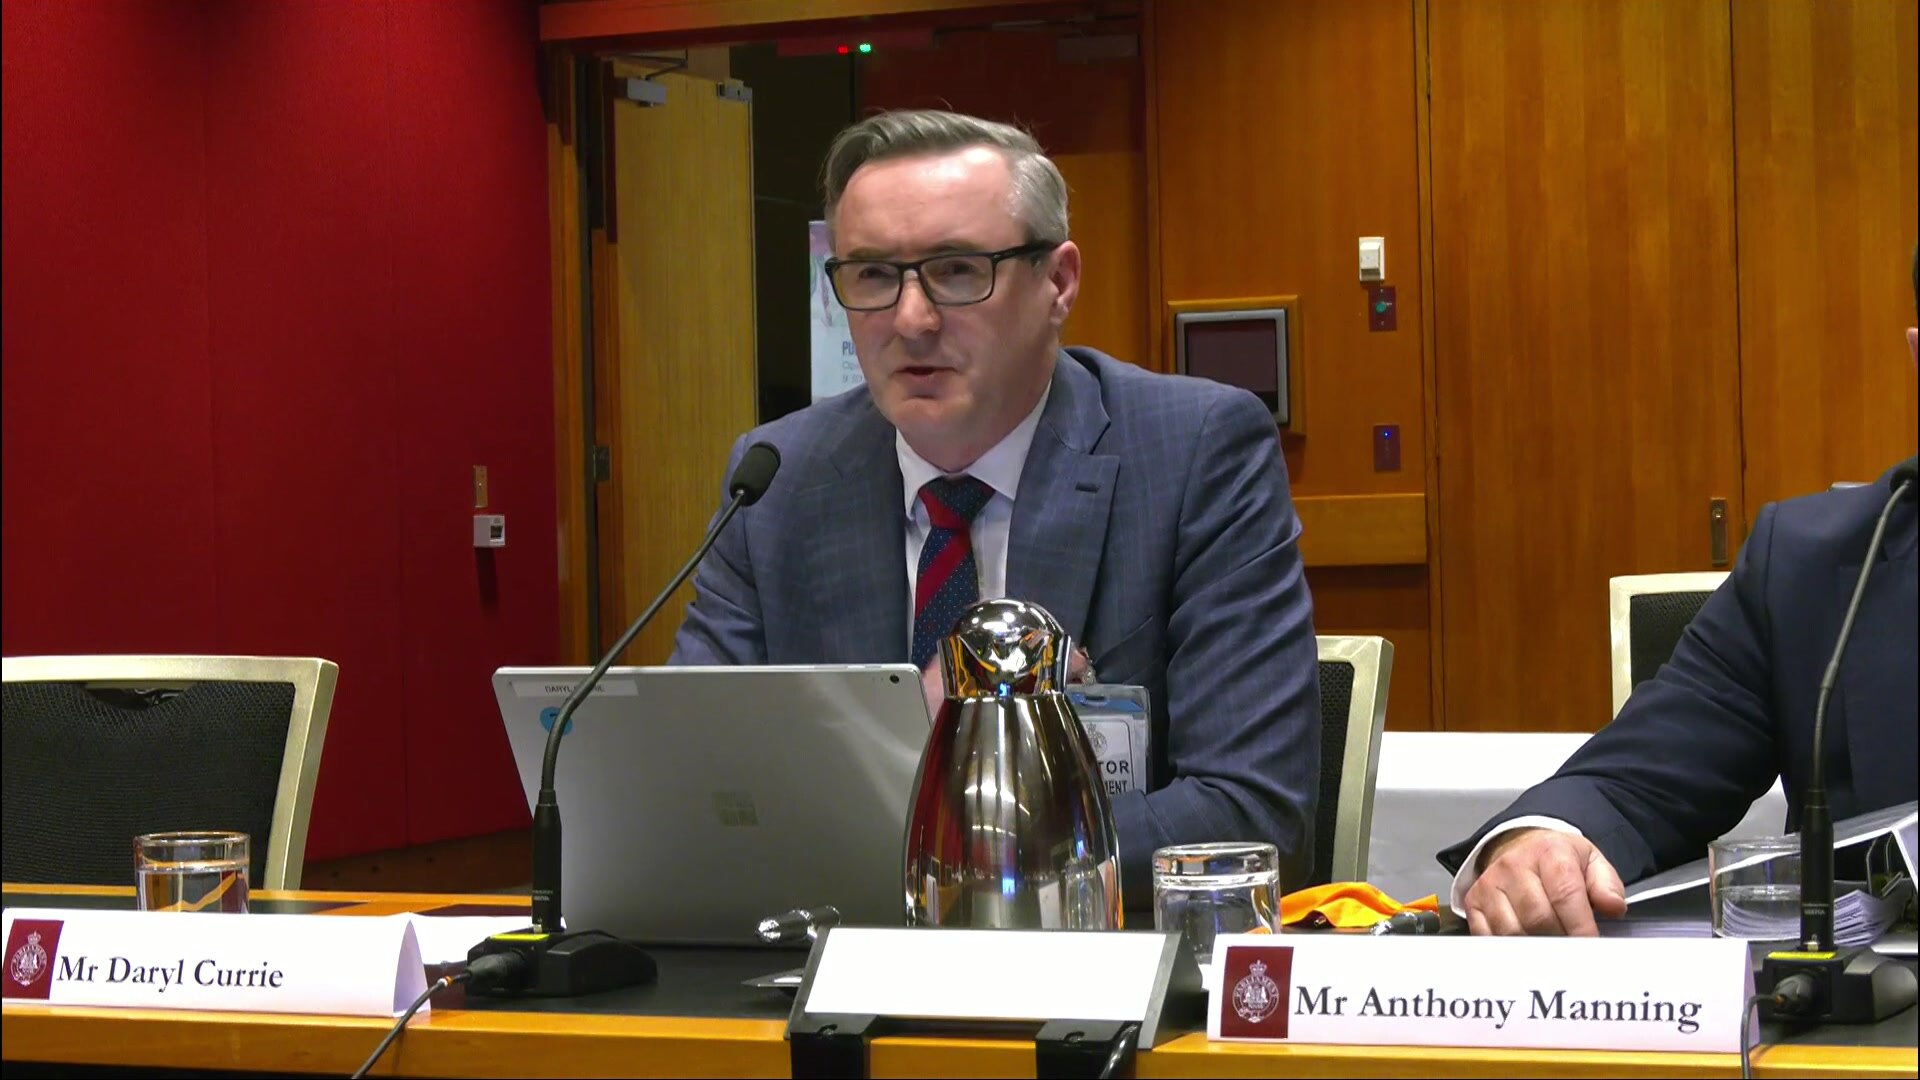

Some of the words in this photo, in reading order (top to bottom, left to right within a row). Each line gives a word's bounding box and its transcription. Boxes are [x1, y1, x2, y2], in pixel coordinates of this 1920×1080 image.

[1104, 780, 1128, 795] ENT
[56, 955, 99, 982] Mr
[106, 957, 184, 993] Daryl
[194, 959, 284, 988] Currie
[1294, 986, 1348, 1016] Mr
[1357, 987, 1516, 1029] Anthony
[1527, 990, 1702, 1033] Manning
